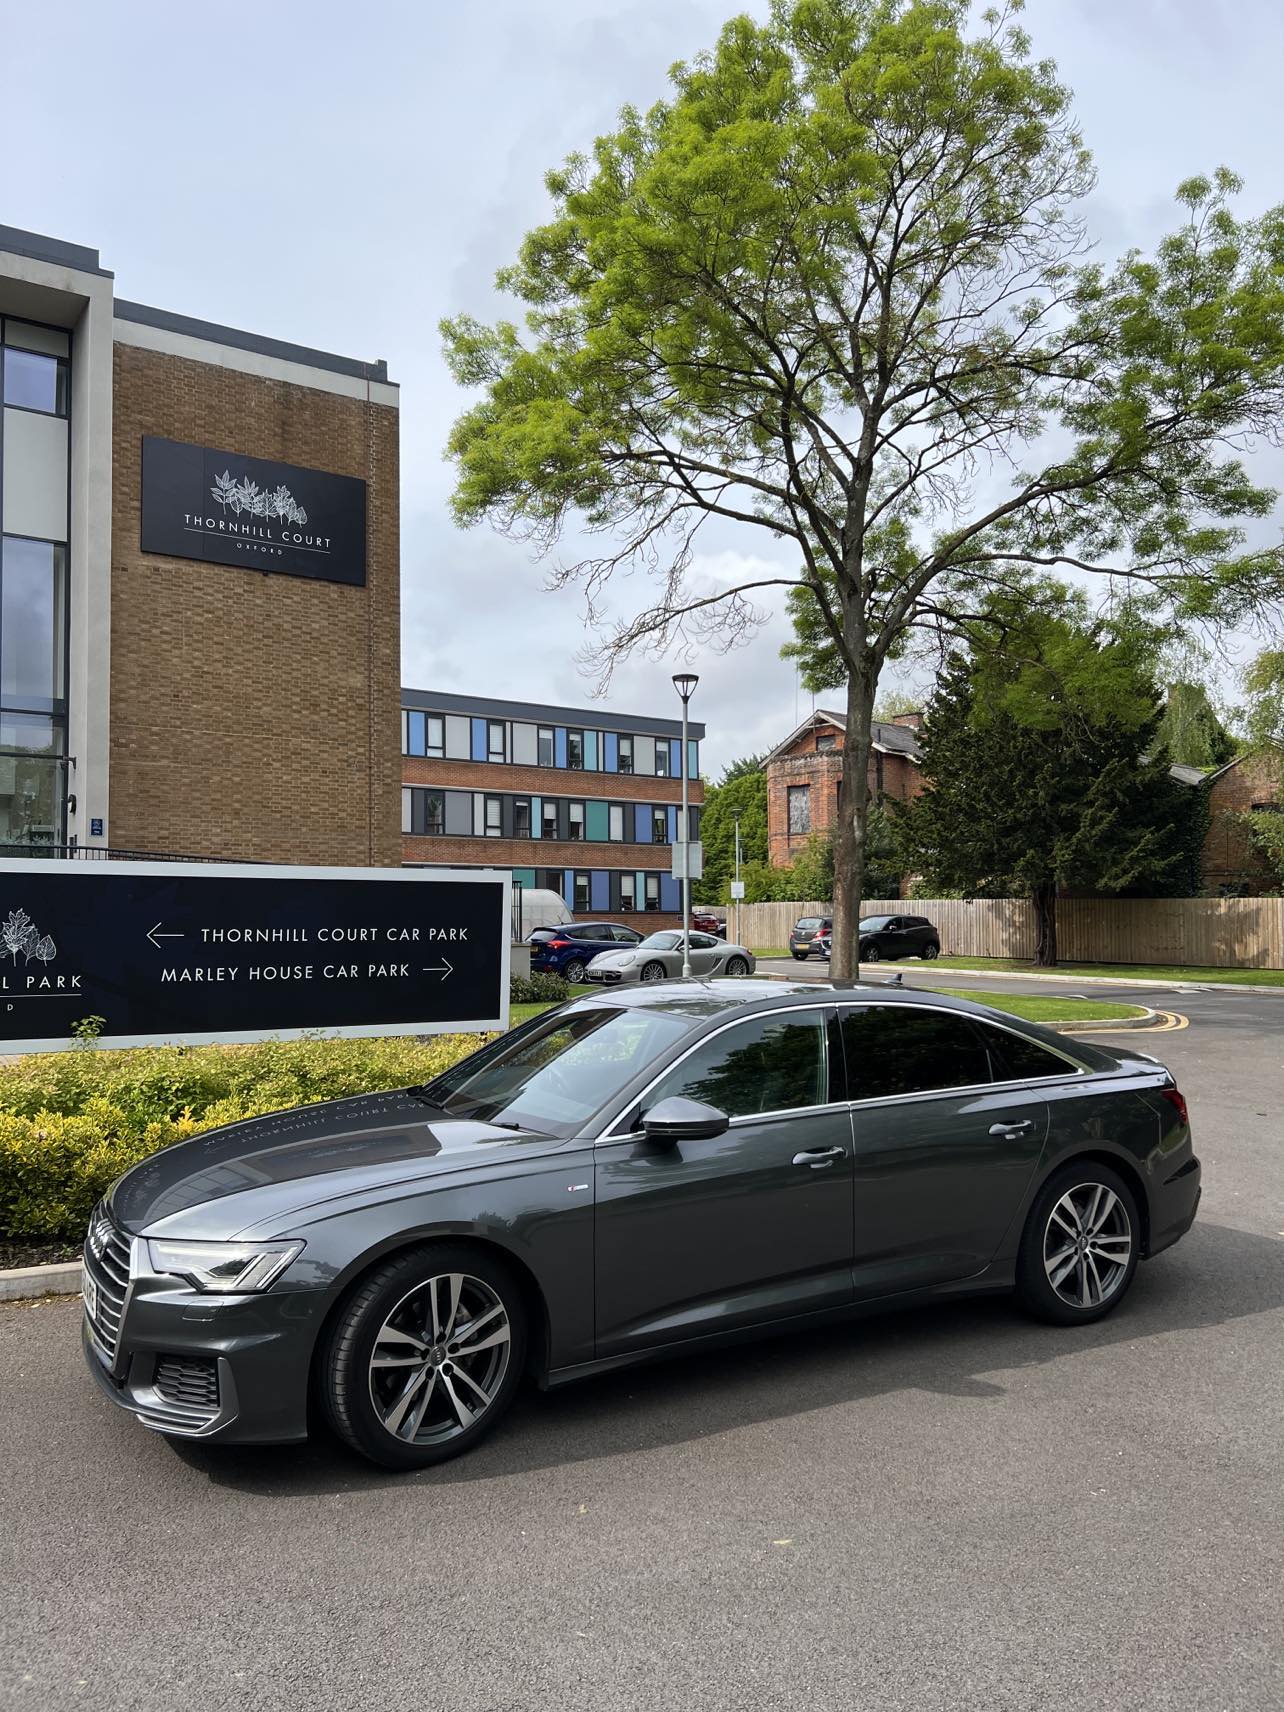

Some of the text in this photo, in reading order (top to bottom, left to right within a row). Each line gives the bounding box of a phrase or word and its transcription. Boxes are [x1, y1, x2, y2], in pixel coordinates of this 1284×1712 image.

[184, 513, 331, 548] THORNHILL COURT
[236, 542, 283, 555] OXFORD
[200, 927, 468, 943] THORNHILL COURT CAR PARK
[160, 963, 409, 982] MARLEY HOUSE CAR PARK
[26, 975, 82, 989] PARK
